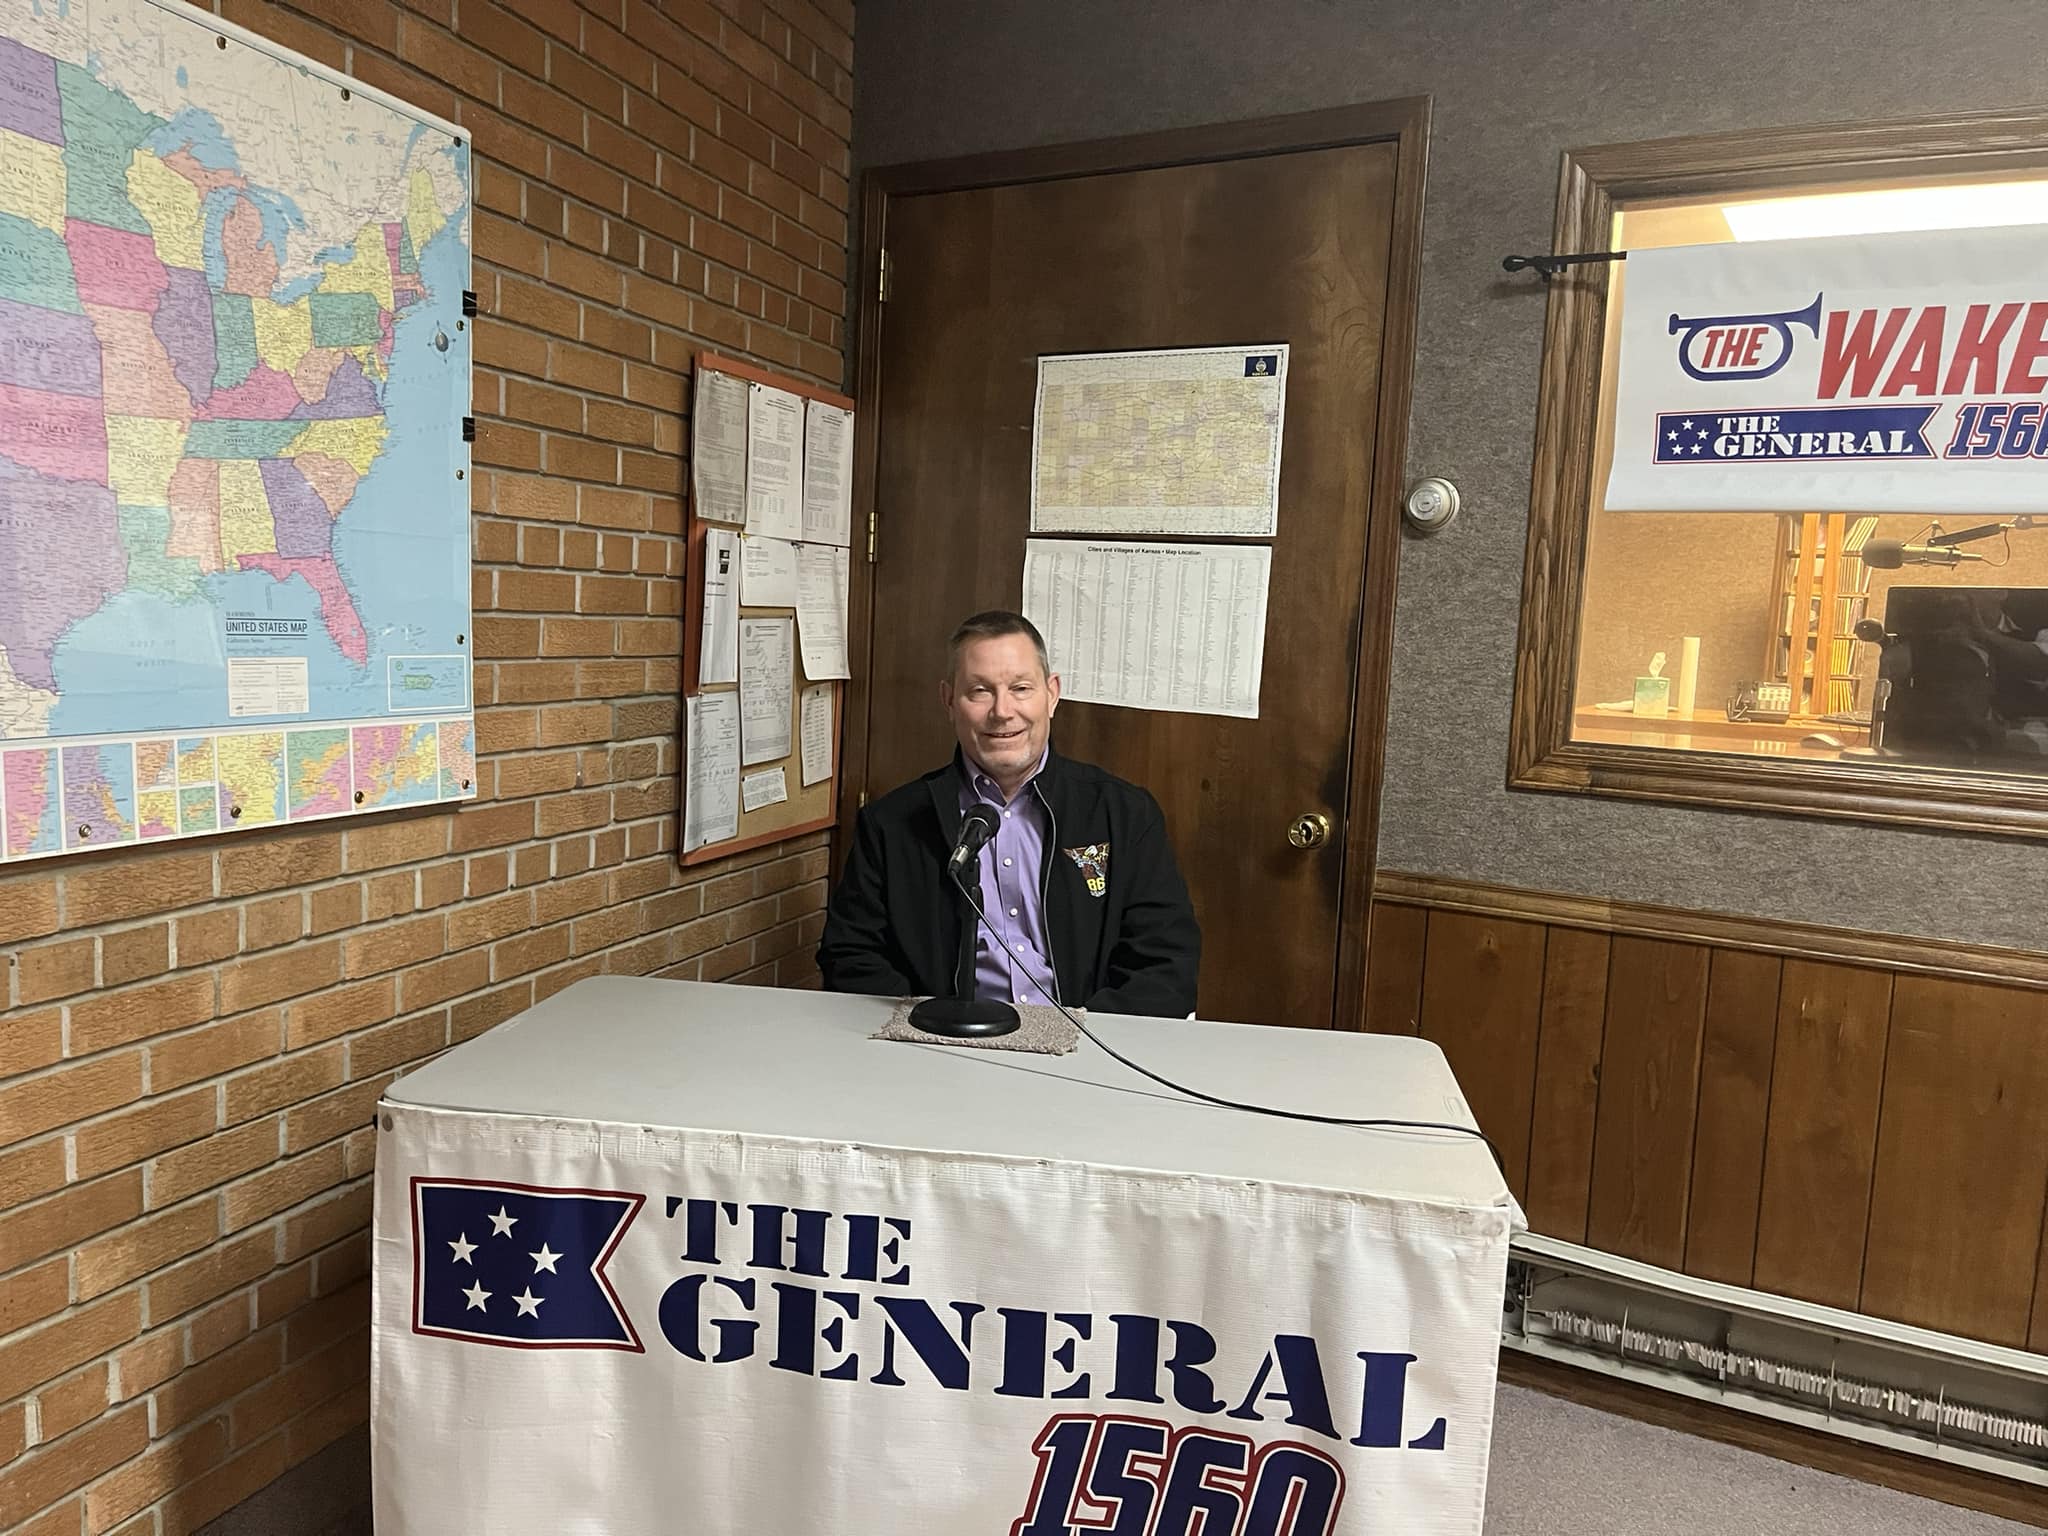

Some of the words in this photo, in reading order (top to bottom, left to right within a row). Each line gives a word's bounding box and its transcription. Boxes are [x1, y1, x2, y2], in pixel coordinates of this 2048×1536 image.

[1701, 327, 1769, 369] THE
[1817, 302, 2048, 399] WAKE
[1713, 430, 1913, 457] GENERAL
[1717, 415, 1780, 434] THE
[225, 621, 257, 633] UNITED
[258, 621, 289, 633] STATES
[290, 622, 308, 633] MAP
[666, 1196, 911, 1286] THE
[658, 1273, 1447, 1450] GENERAL
[1009, 1413, 1346, 1536] 1560
